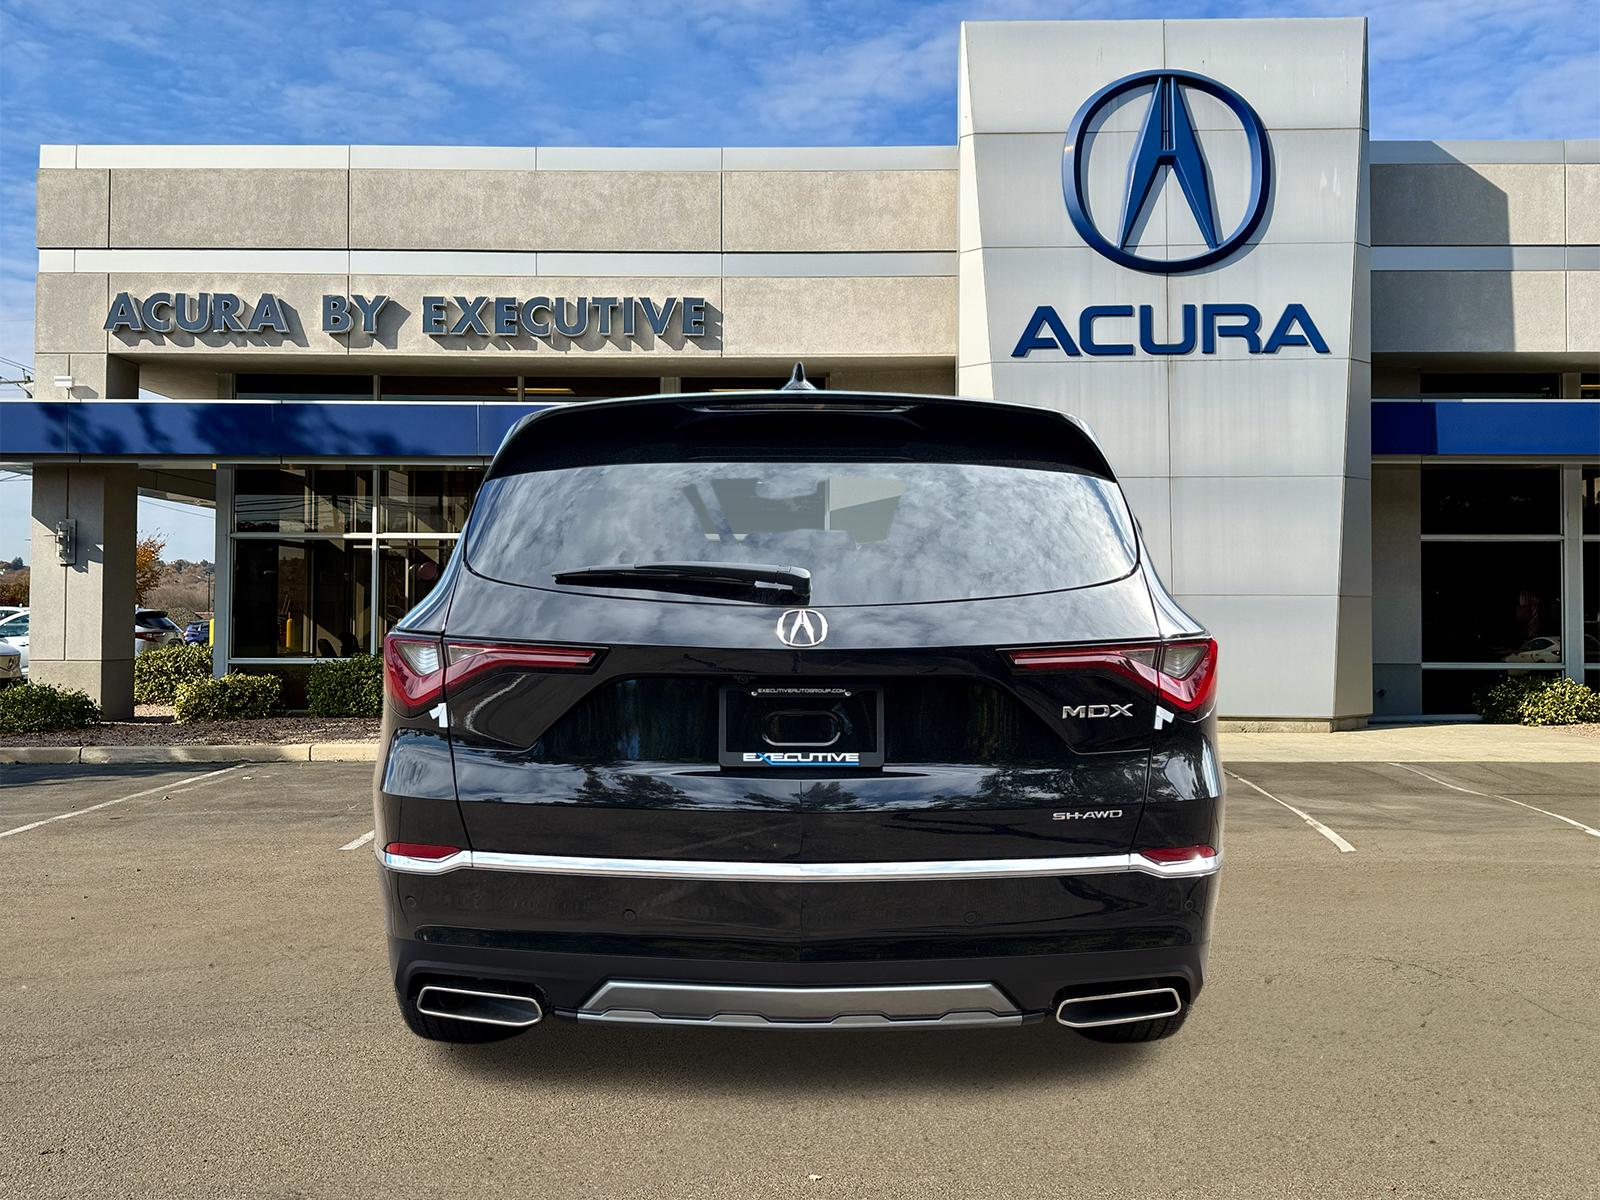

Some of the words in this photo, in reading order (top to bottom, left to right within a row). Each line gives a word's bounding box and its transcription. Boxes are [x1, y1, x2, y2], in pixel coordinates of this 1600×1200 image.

[103, 291, 289, 334] ACURA
[322, 293, 388, 334] BY
[421, 296, 707, 337] EXECUTIVE
[1010, 303, 1333, 358] ACURA
[1062, 703, 1134, 719] MDX
[743, 752, 860, 763] EXECUTIVE
[1052, 809, 1123, 820] SH-AWD
